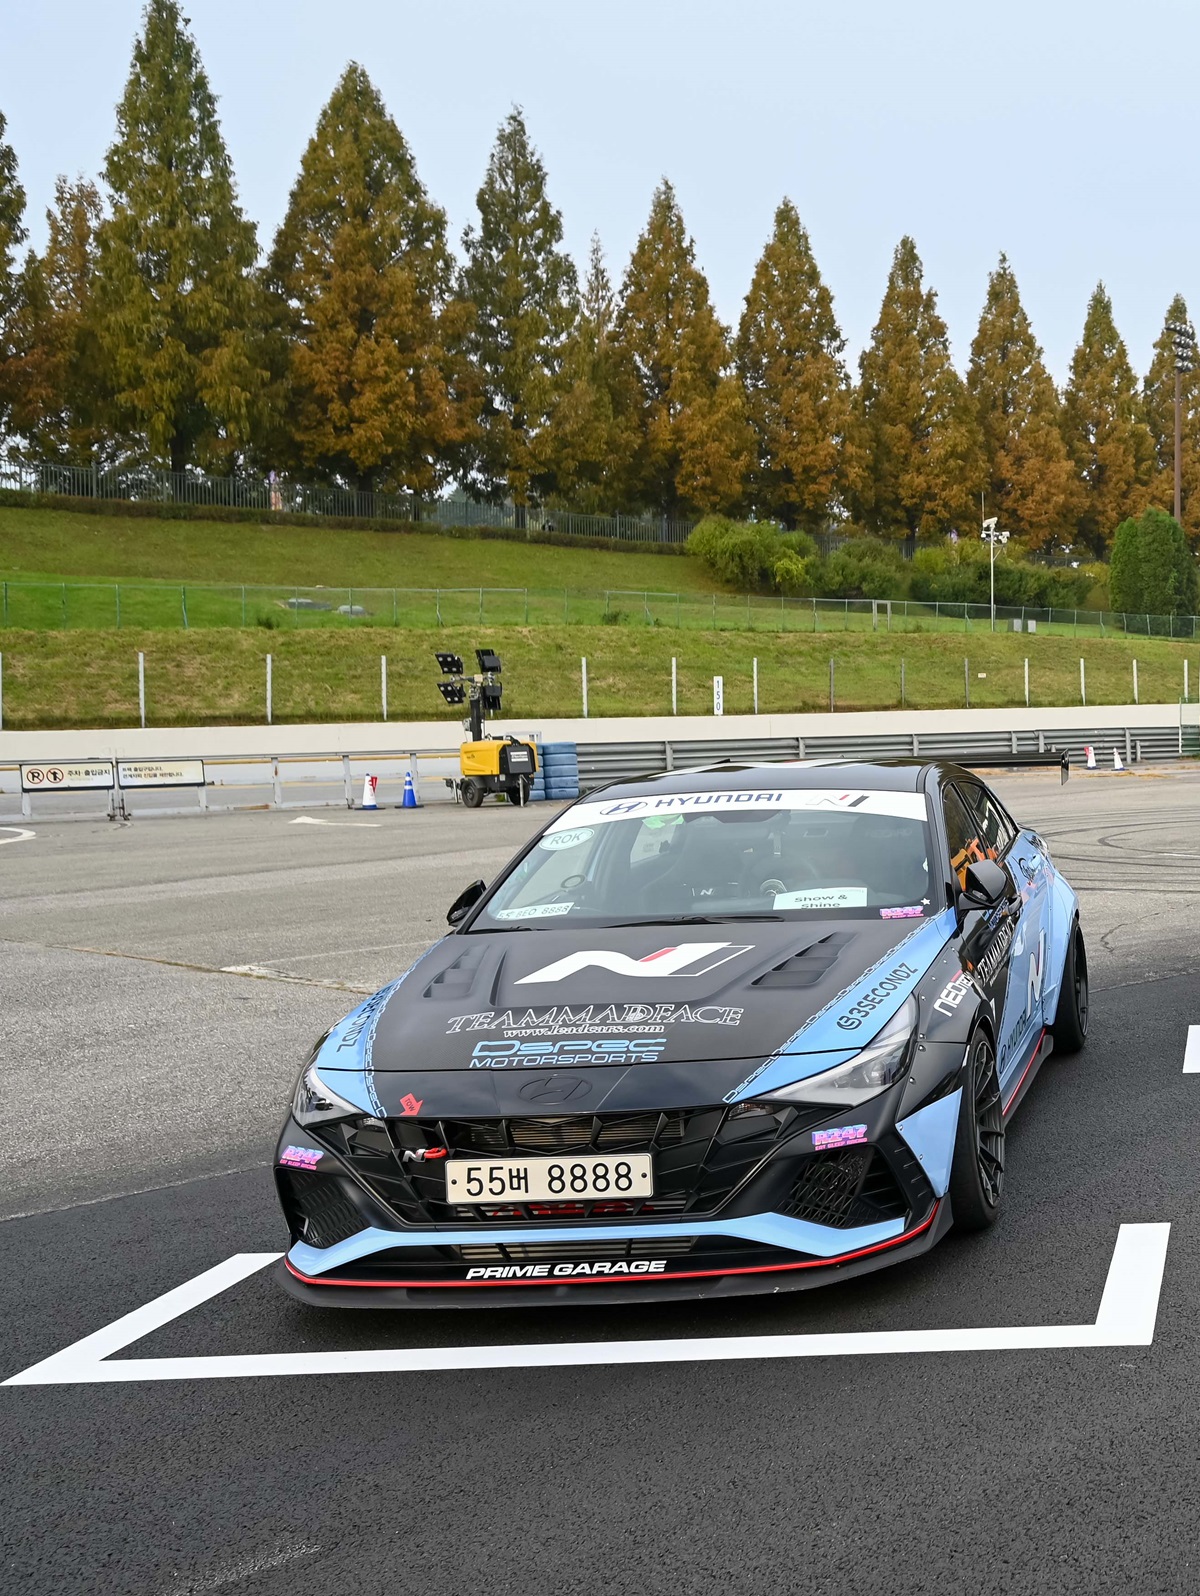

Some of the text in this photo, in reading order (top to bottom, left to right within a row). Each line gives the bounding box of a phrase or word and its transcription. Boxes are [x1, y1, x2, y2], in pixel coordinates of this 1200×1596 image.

[655, 793, 783, 808] HYUNDAI
[550, 832, 583, 846] ROK
[541, 905, 570, 915] 8888
[504, 1024, 665, 1037] www.leadcars.com
[469, 1053, 659, 1069] MOTORSPORTS
[404, 1097, 415, 1112] TOW
[466, 1161, 633, 1196] 55버 8888
[466, 1260, 667, 1279] PRIME GARAGE
